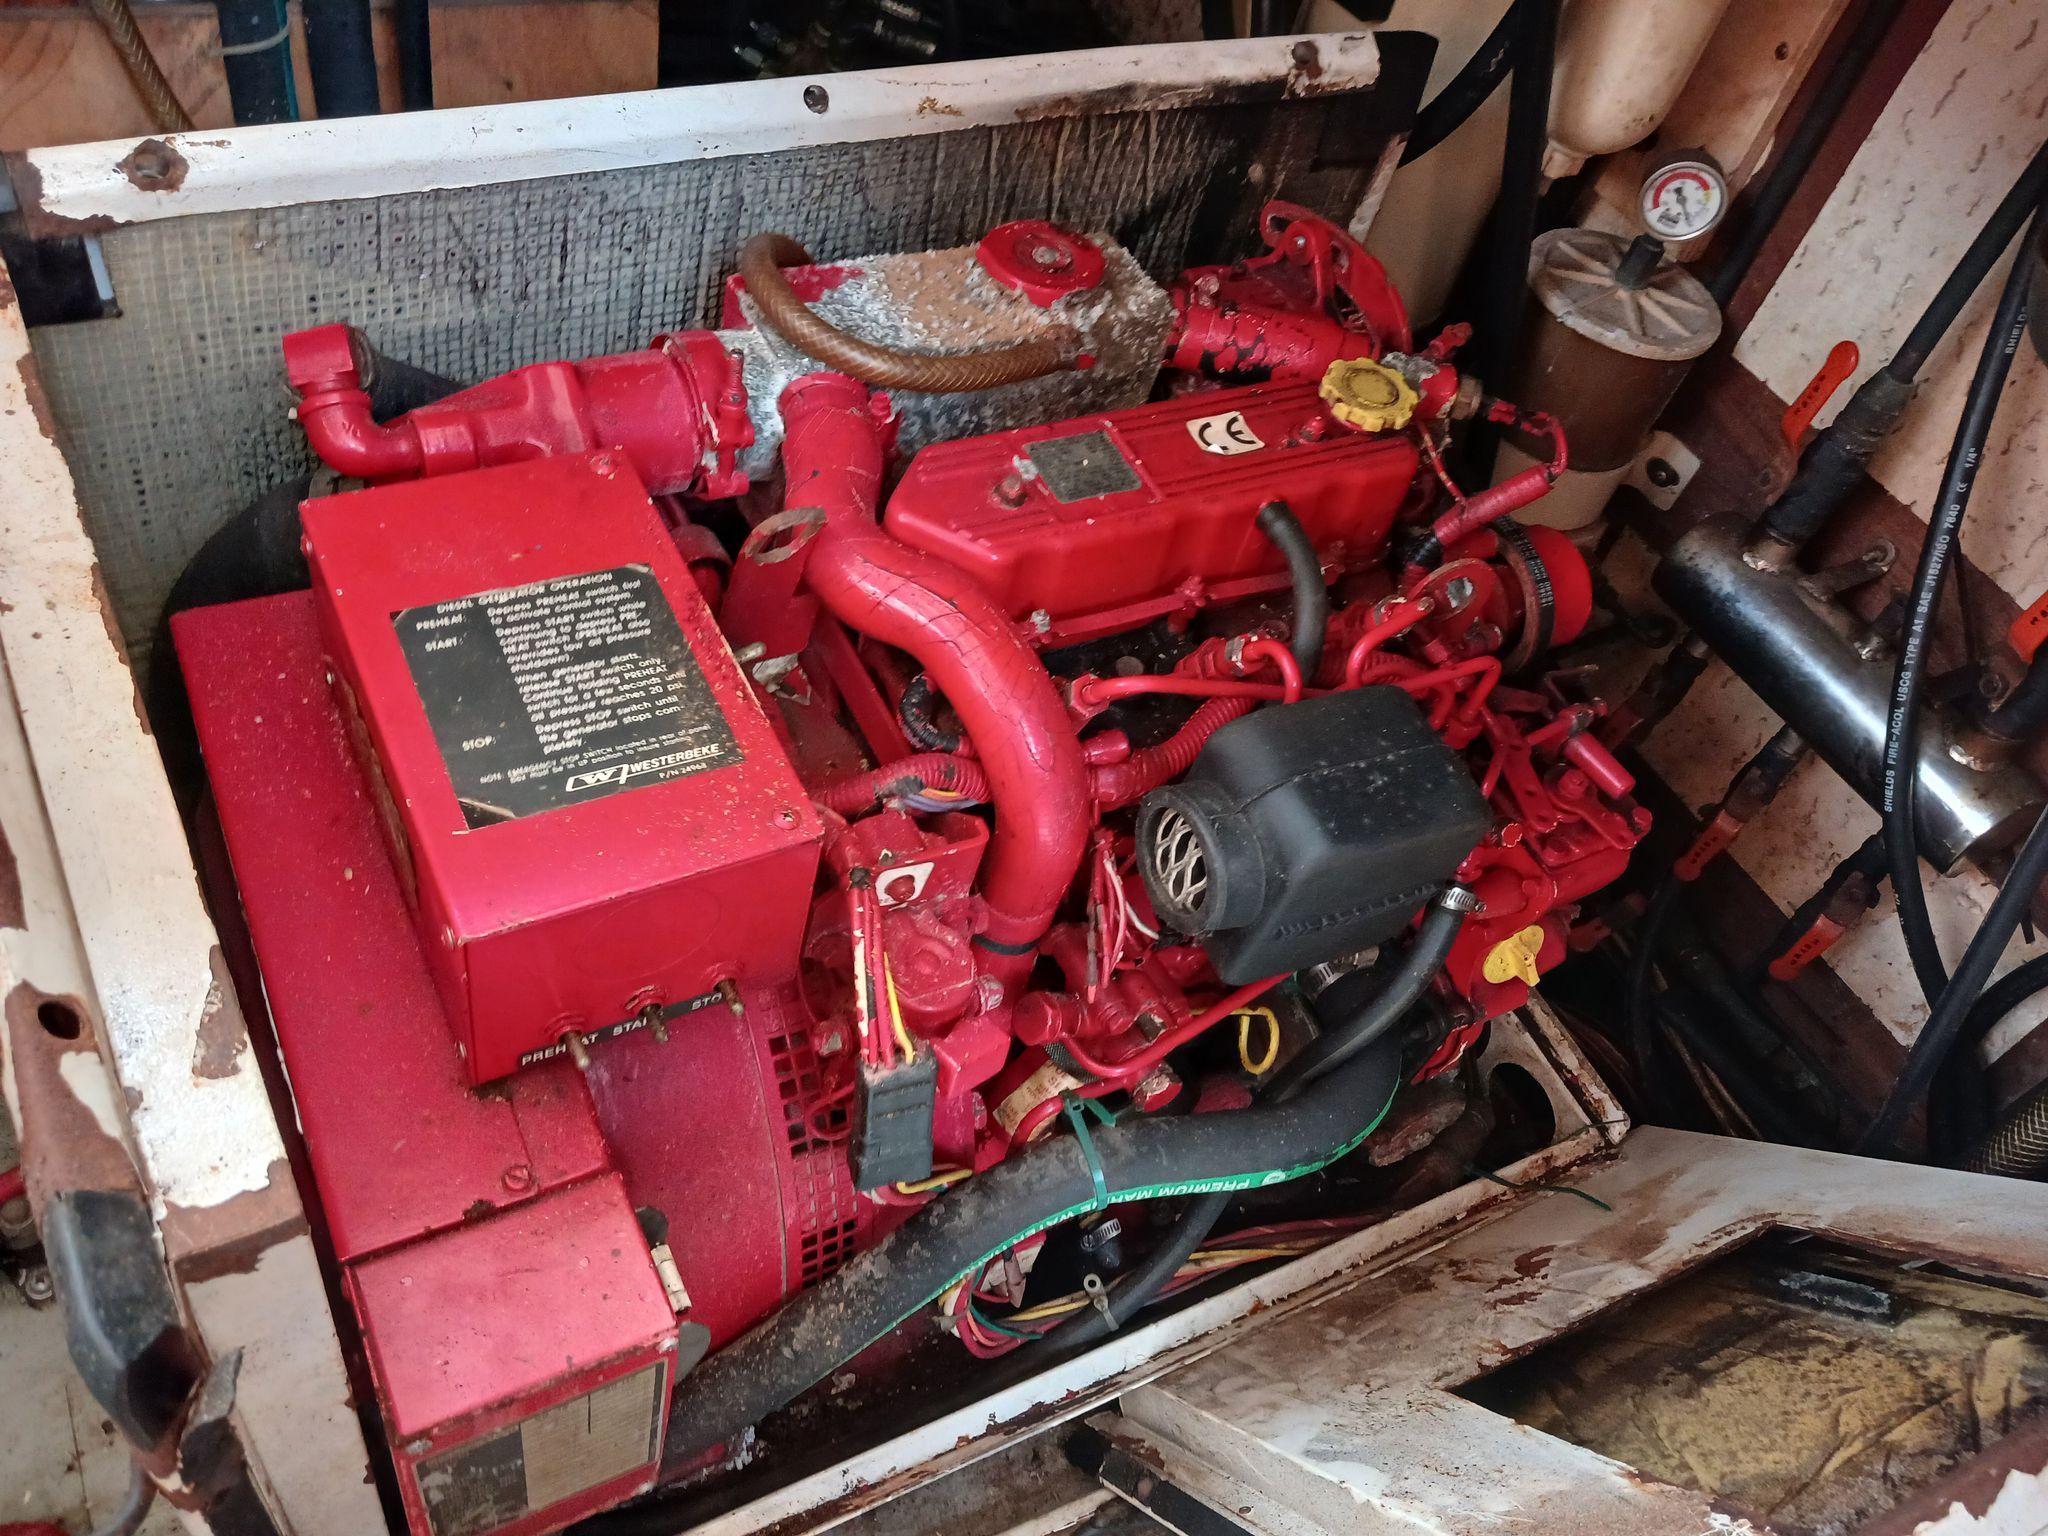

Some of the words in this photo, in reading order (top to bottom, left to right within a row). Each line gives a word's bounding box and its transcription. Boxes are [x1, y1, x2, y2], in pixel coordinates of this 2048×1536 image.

[1917, 592, 1932, 613] SAE
[1904, 637, 1920, 666] TYPE
[552, 660, 604, 678] generator
[600, 663, 634, 676] switch
[624, 665, 666, 679] PREHEAT
[601, 691, 645, 705] reaches
[649, 685, 663, 694] 20
[618, 677, 661, 691] seconds
[1896, 671, 1913, 701] USCG
[584, 709, 611, 722] STOP
[617, 702, 651, 715] switch
[655, 695, 678, 705] until
[563, 720, 617, 739] generator
[623, 713, 651, 723] stops
[655, 706, 684, 715] com-
[1887, 706, 1905, 765] FIRE-ACOL
[630, 744, 718, 772] WESTERBEKE
[1884, 770, 1896, 813] SHIELDS
[522, 1032, 599, 1066] PREHAT
[691, 992, 722, 1010] STO
[1158, 1179, 1250, 1197] PREMIUM
[1081, 1190, 1153, 1213] MARE
